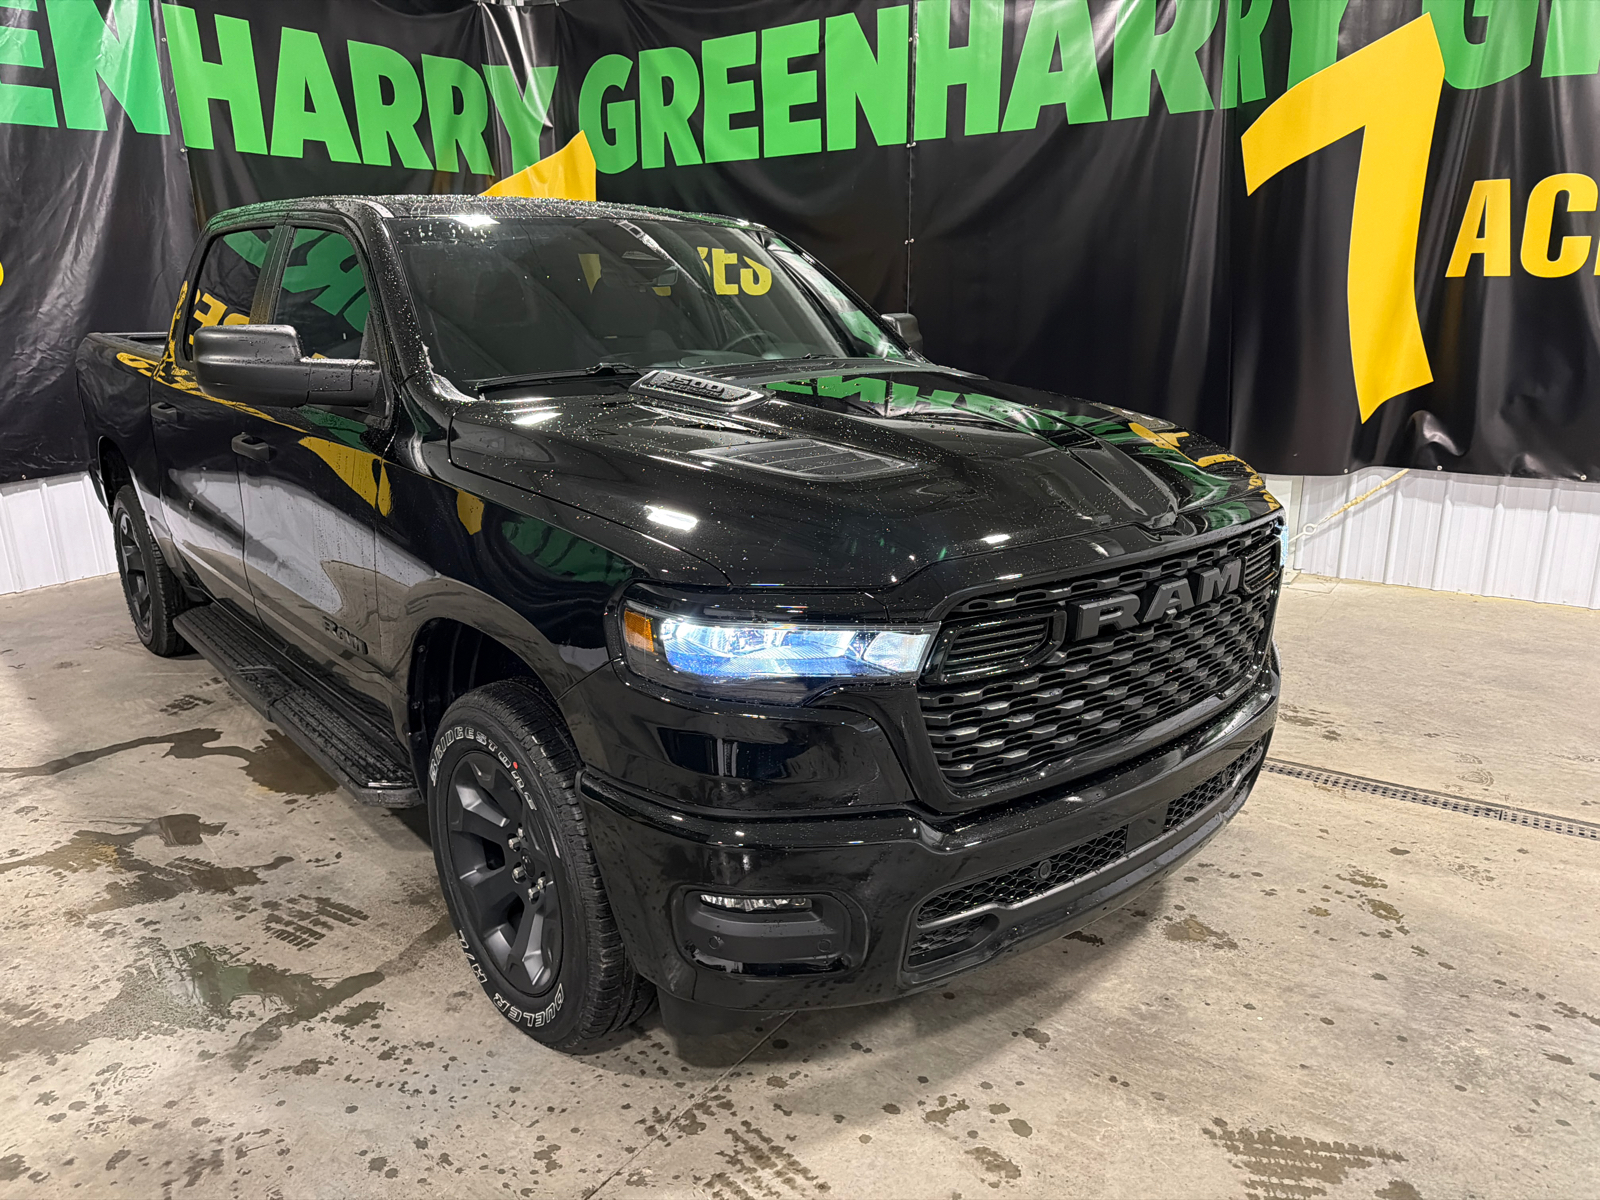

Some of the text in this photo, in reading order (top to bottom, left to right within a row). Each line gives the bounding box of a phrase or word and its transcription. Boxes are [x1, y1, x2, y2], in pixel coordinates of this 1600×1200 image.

[163, 3, 910, 175] HARRY GREEN
[1241, 12, 1600, 424] 7 AC
[1075, 557, 1243, 642] RAM
[428, 726, 538, 811] BRIDGESTONE
[493, 983, 565, 1028] DUELER
